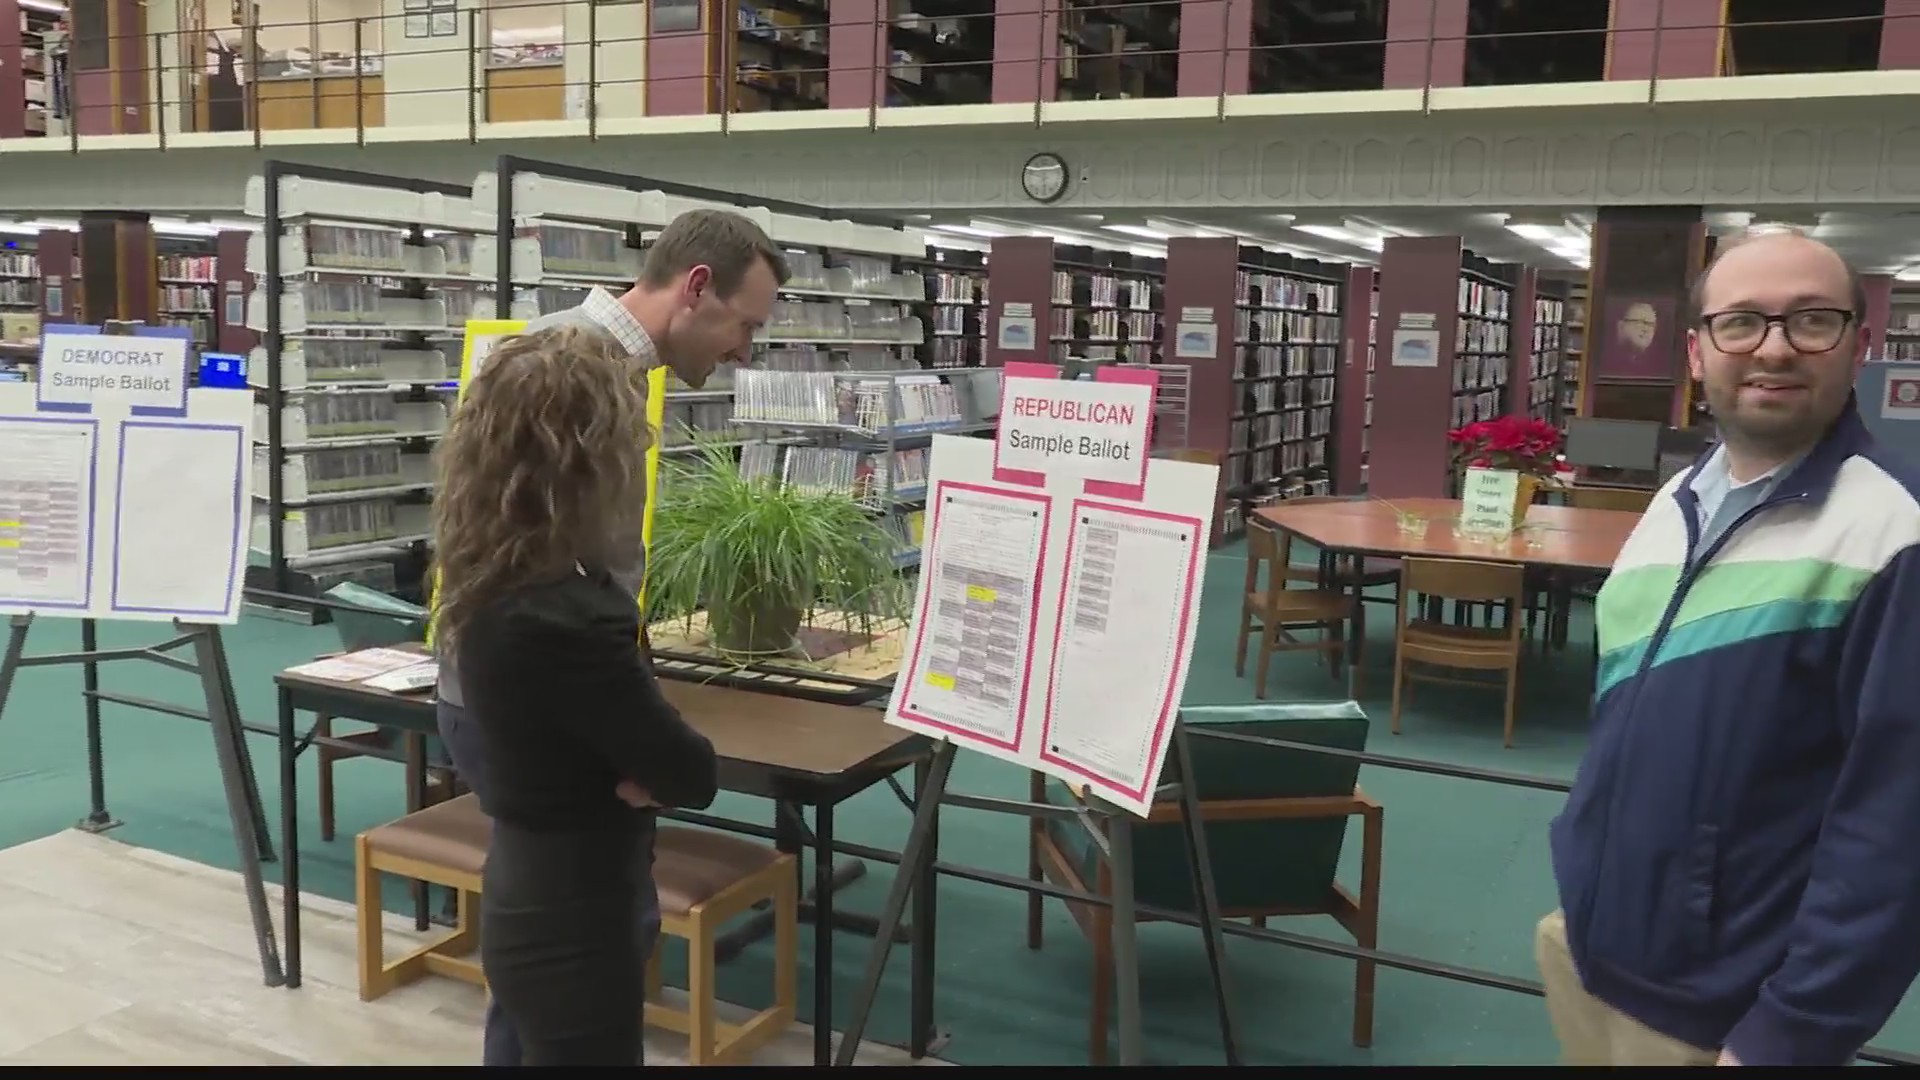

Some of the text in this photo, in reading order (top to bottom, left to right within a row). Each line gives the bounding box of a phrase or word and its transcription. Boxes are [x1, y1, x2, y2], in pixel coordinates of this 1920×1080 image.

[62, 348, 164, 366] DEMOCRAT
[52, 371, 171, 392] Sample Ballot
[1013, 396, 1134, 425] REPUBLICAN
[1010, 429, 1131, 461] Sample Ballot
